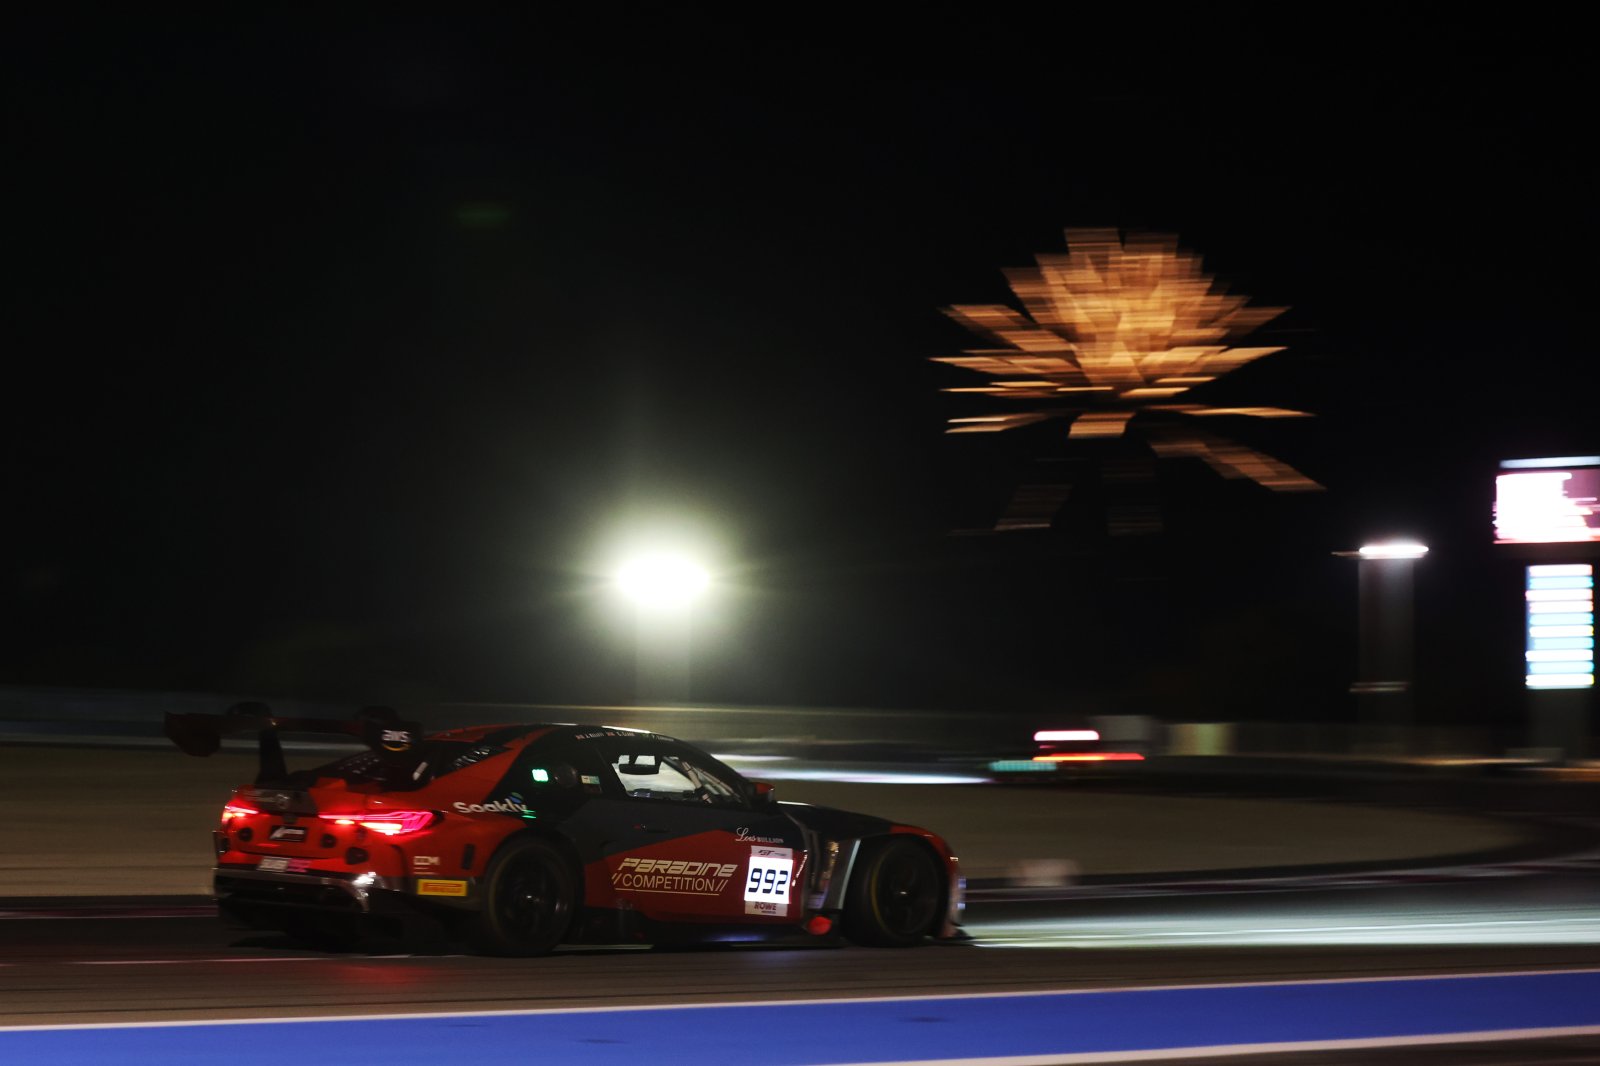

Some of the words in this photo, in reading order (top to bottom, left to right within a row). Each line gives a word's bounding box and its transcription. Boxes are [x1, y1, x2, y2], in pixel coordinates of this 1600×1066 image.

[452, 798, 528, 816] Soakly
[748, 868, 789, 895] 992
[754, 902, 777, 911] ROWE
